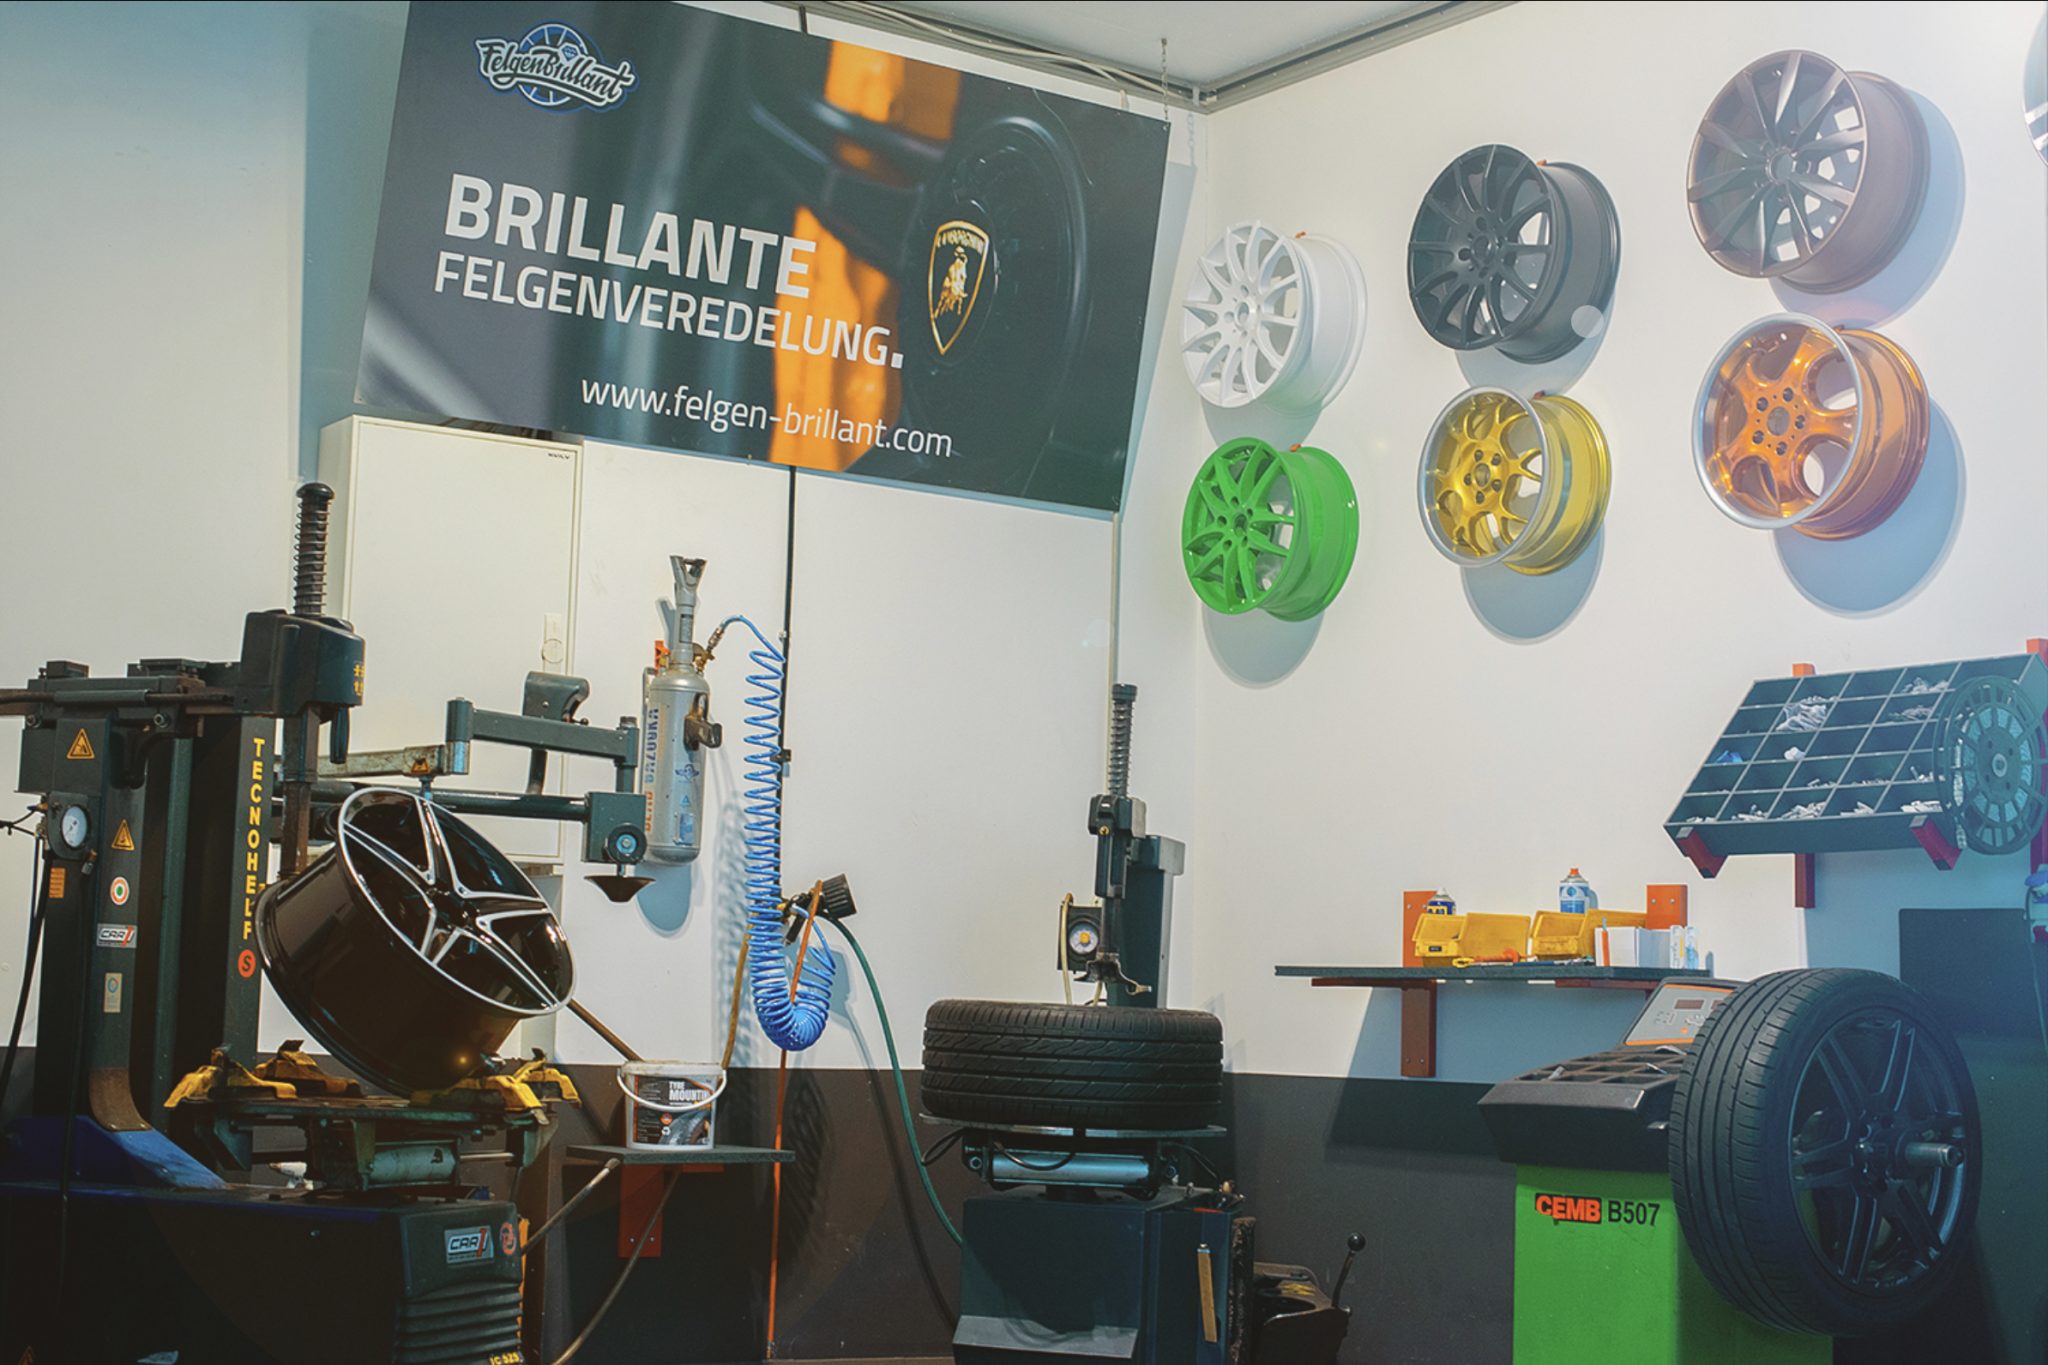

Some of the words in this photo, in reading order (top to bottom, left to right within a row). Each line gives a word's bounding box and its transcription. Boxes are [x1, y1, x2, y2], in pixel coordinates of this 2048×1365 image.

[444, 173, 817, 299] BRILLANTE
[434, 250, 904, 369] FELGENVEREDELUNG.
[581, 379, 953, 457] www.felgen-brillant.com
[1536, 1194, 1601, 1222] CEMB
[1607, 1200, 1660, 1226] B507
